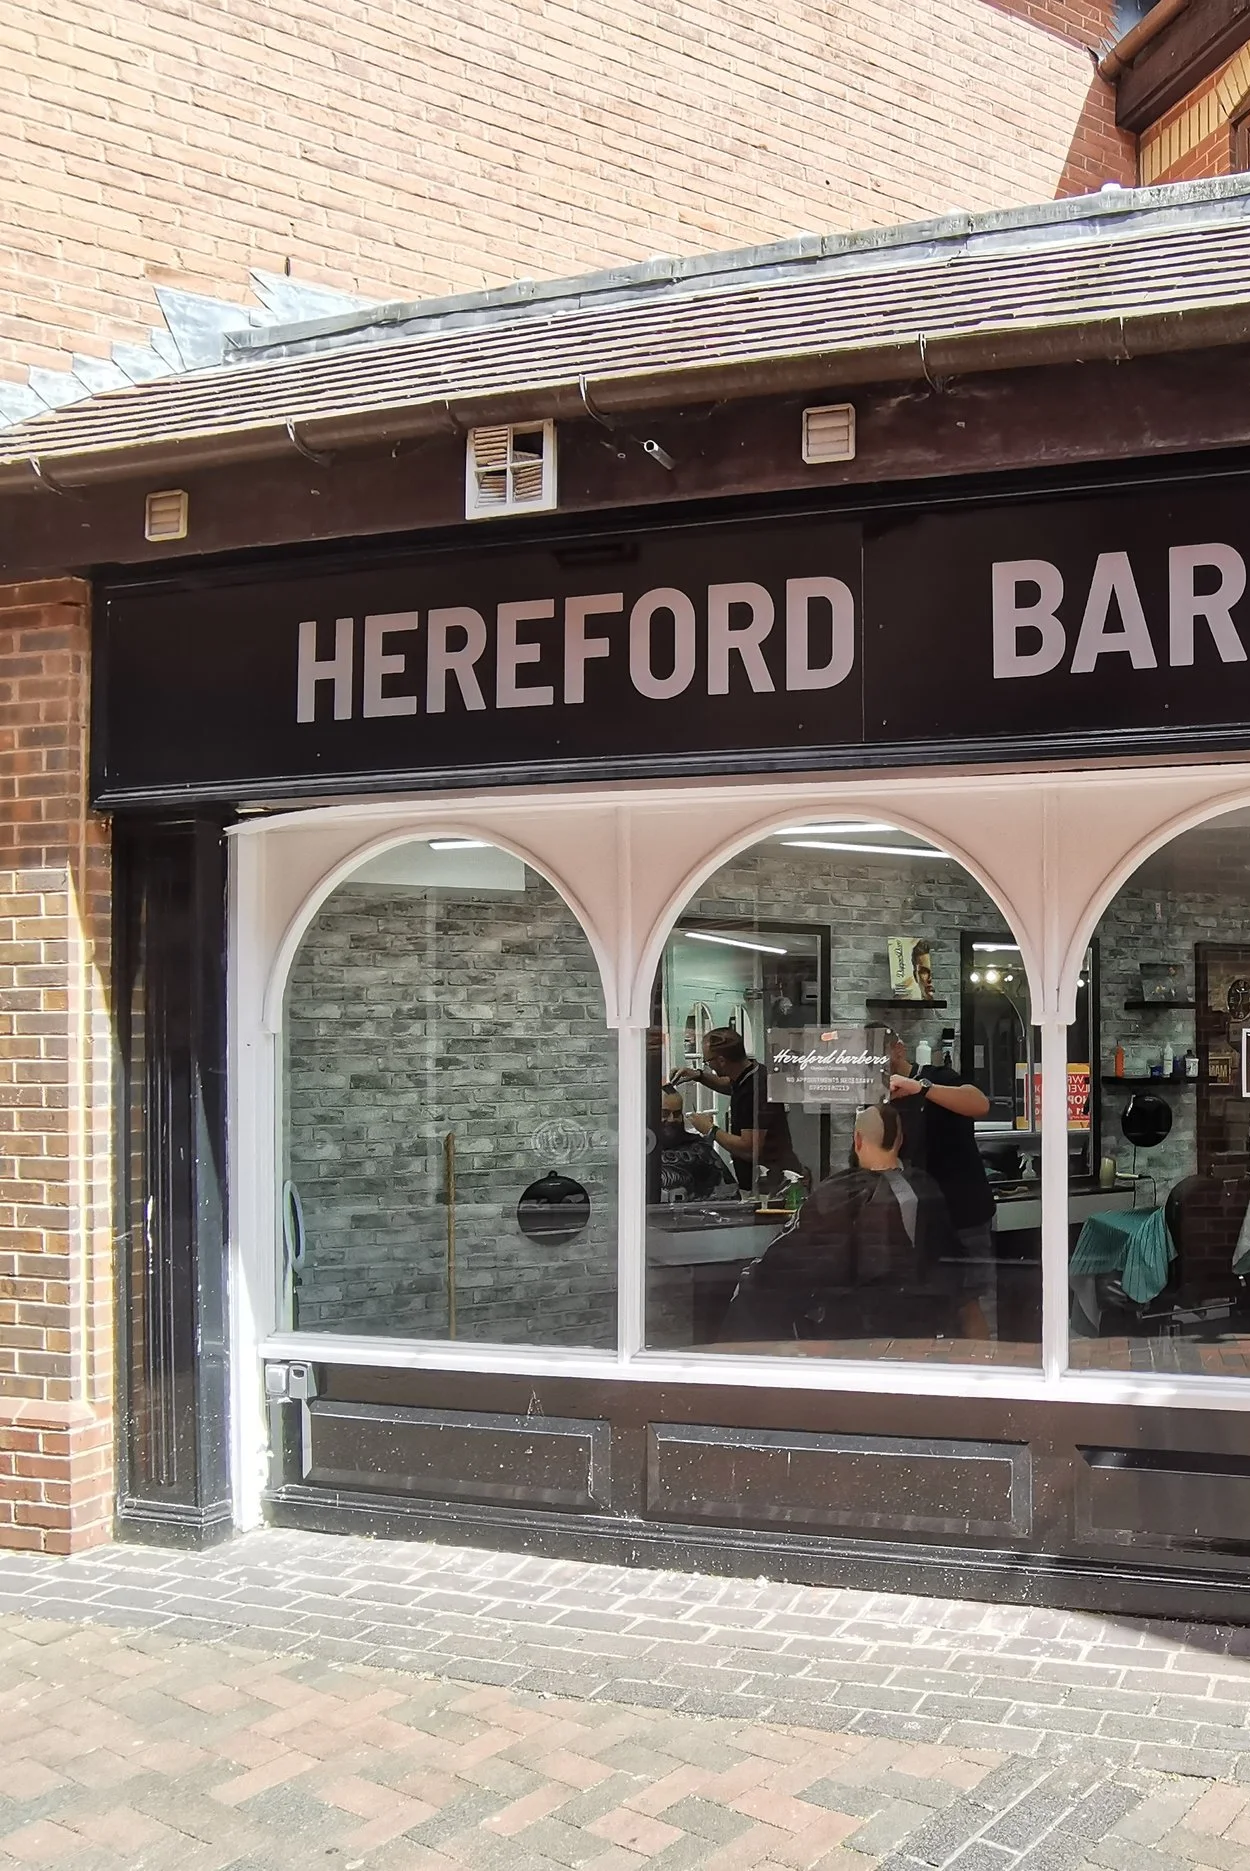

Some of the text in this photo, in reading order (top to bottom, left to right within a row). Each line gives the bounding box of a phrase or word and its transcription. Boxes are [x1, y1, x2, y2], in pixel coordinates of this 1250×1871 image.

[296, 575, 855, 724] HEREFORD
[773, 1048, 890, 1071] Hereford barbers
